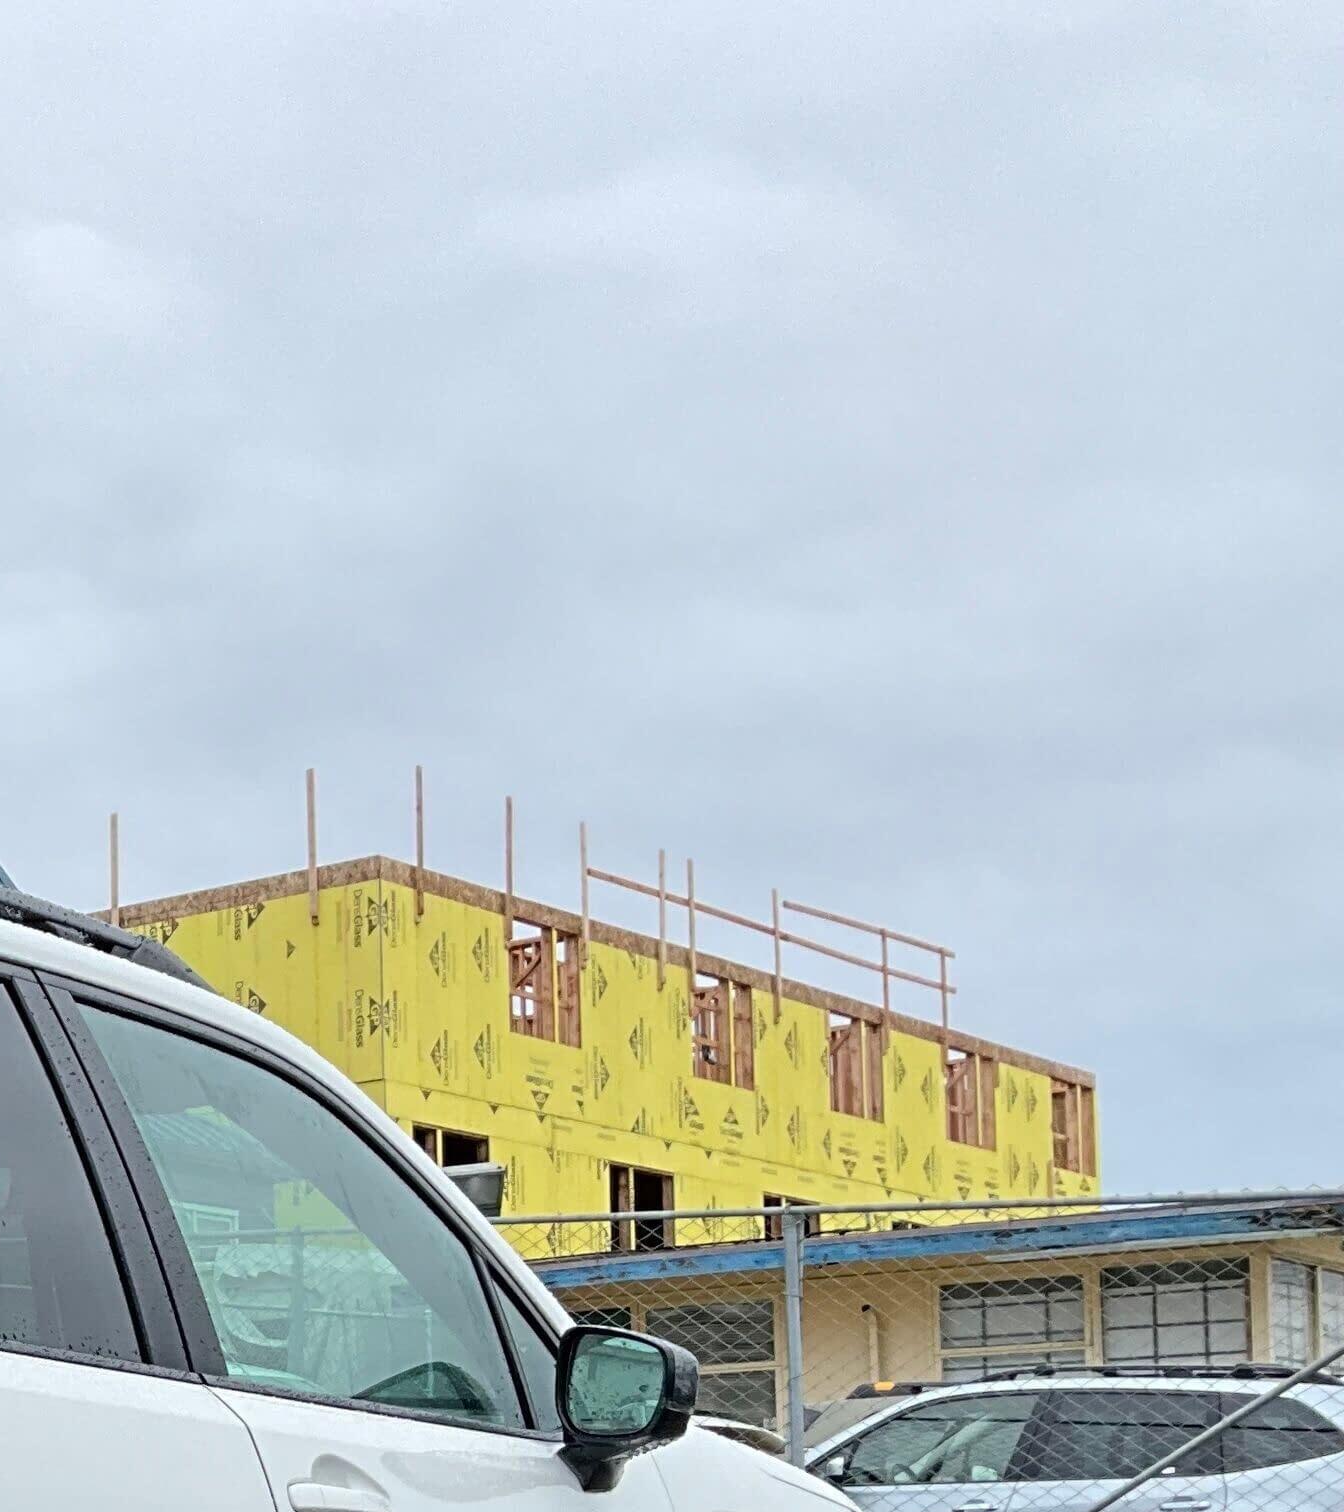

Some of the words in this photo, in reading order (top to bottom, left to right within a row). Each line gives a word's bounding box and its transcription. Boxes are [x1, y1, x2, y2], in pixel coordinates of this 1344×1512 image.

[234, 909, 243, 941] Glass
[353, 889, 363, 948] DensGlass
[355, 989, 365, 1048] DensGlass
